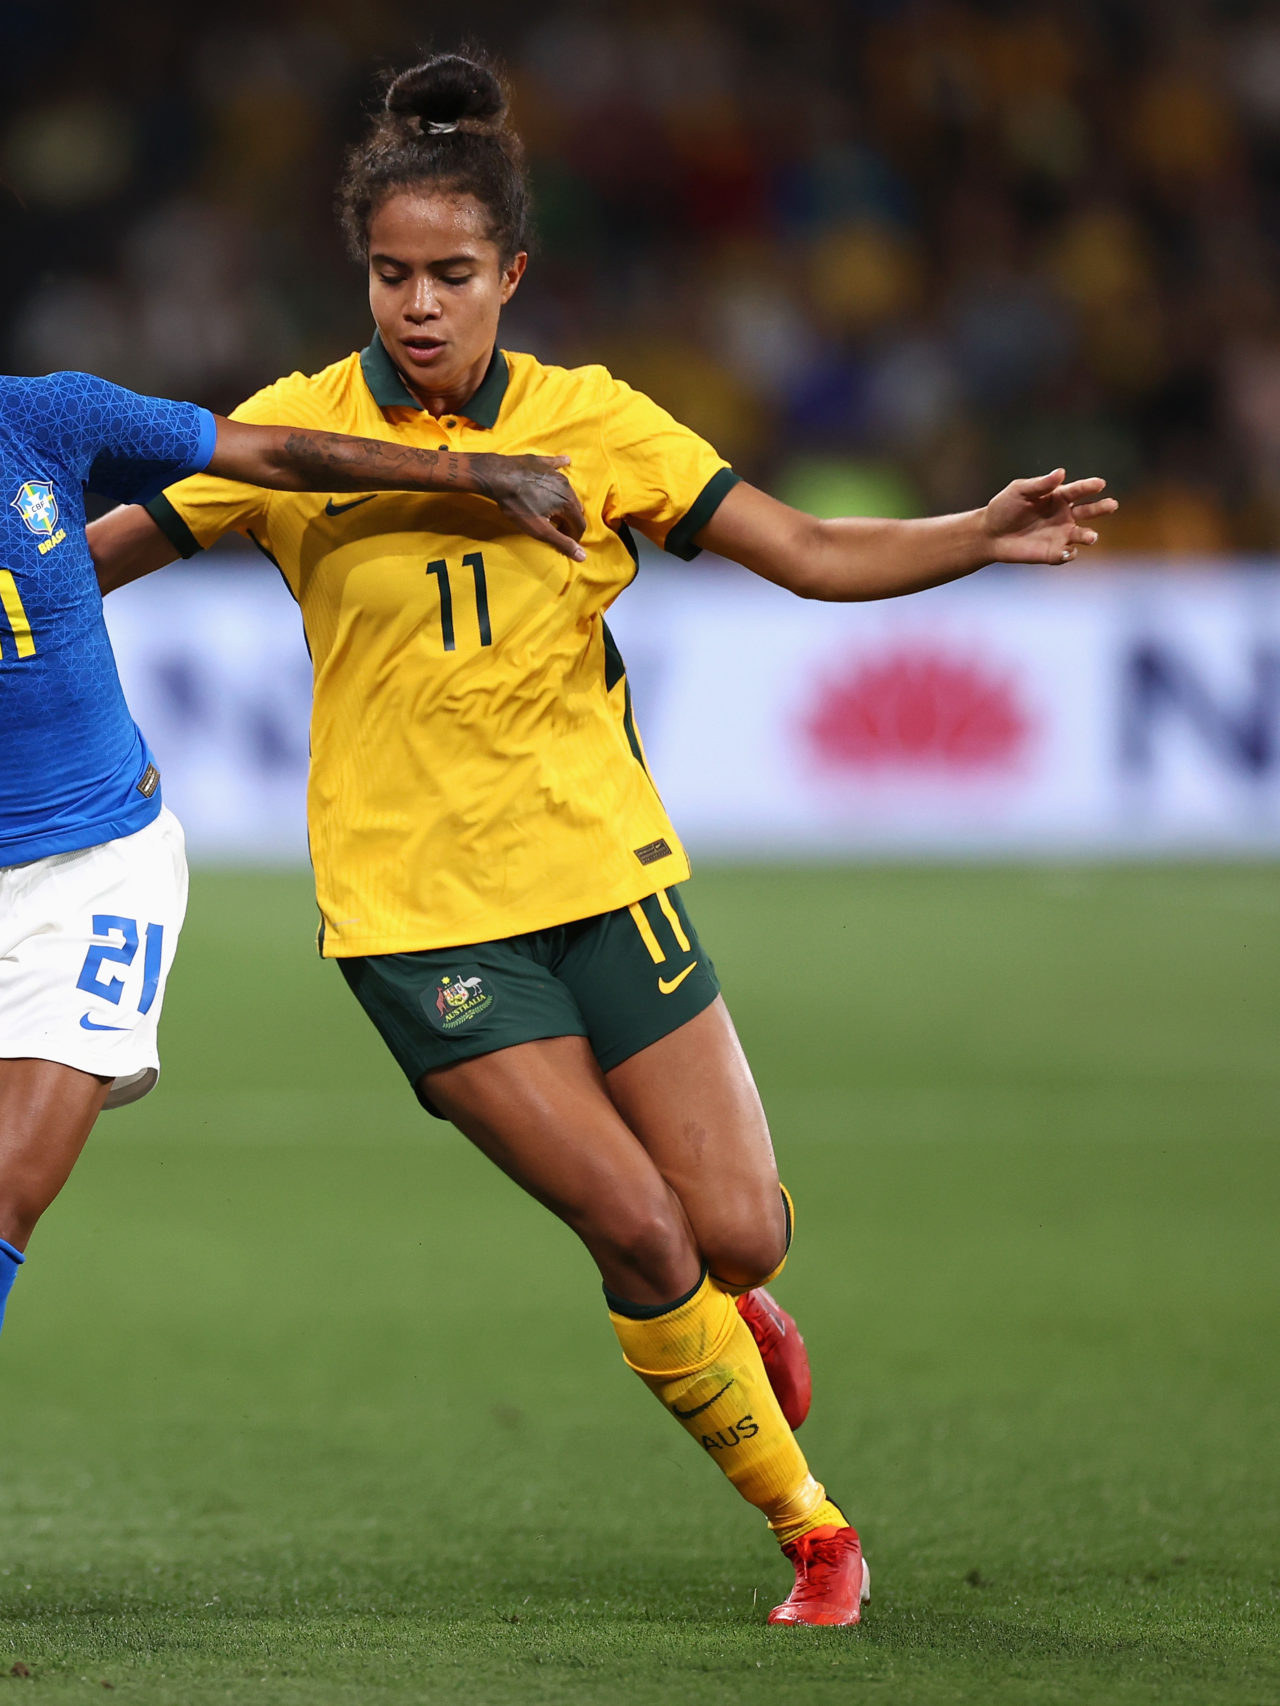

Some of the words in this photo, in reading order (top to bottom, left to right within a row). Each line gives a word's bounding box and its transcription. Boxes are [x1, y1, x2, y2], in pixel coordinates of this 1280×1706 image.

[31, 501, 45, 513] CBF
[38, 528, 66, 555] BRASIL
[425, 551, 492, 651] 11
[628, 888, 691, 965] 11
[76, 914, 164, 1016] 21
[445, 994, 487, 1022] AUSTRALIA
[702, 1414, 759, 1451] AUS
